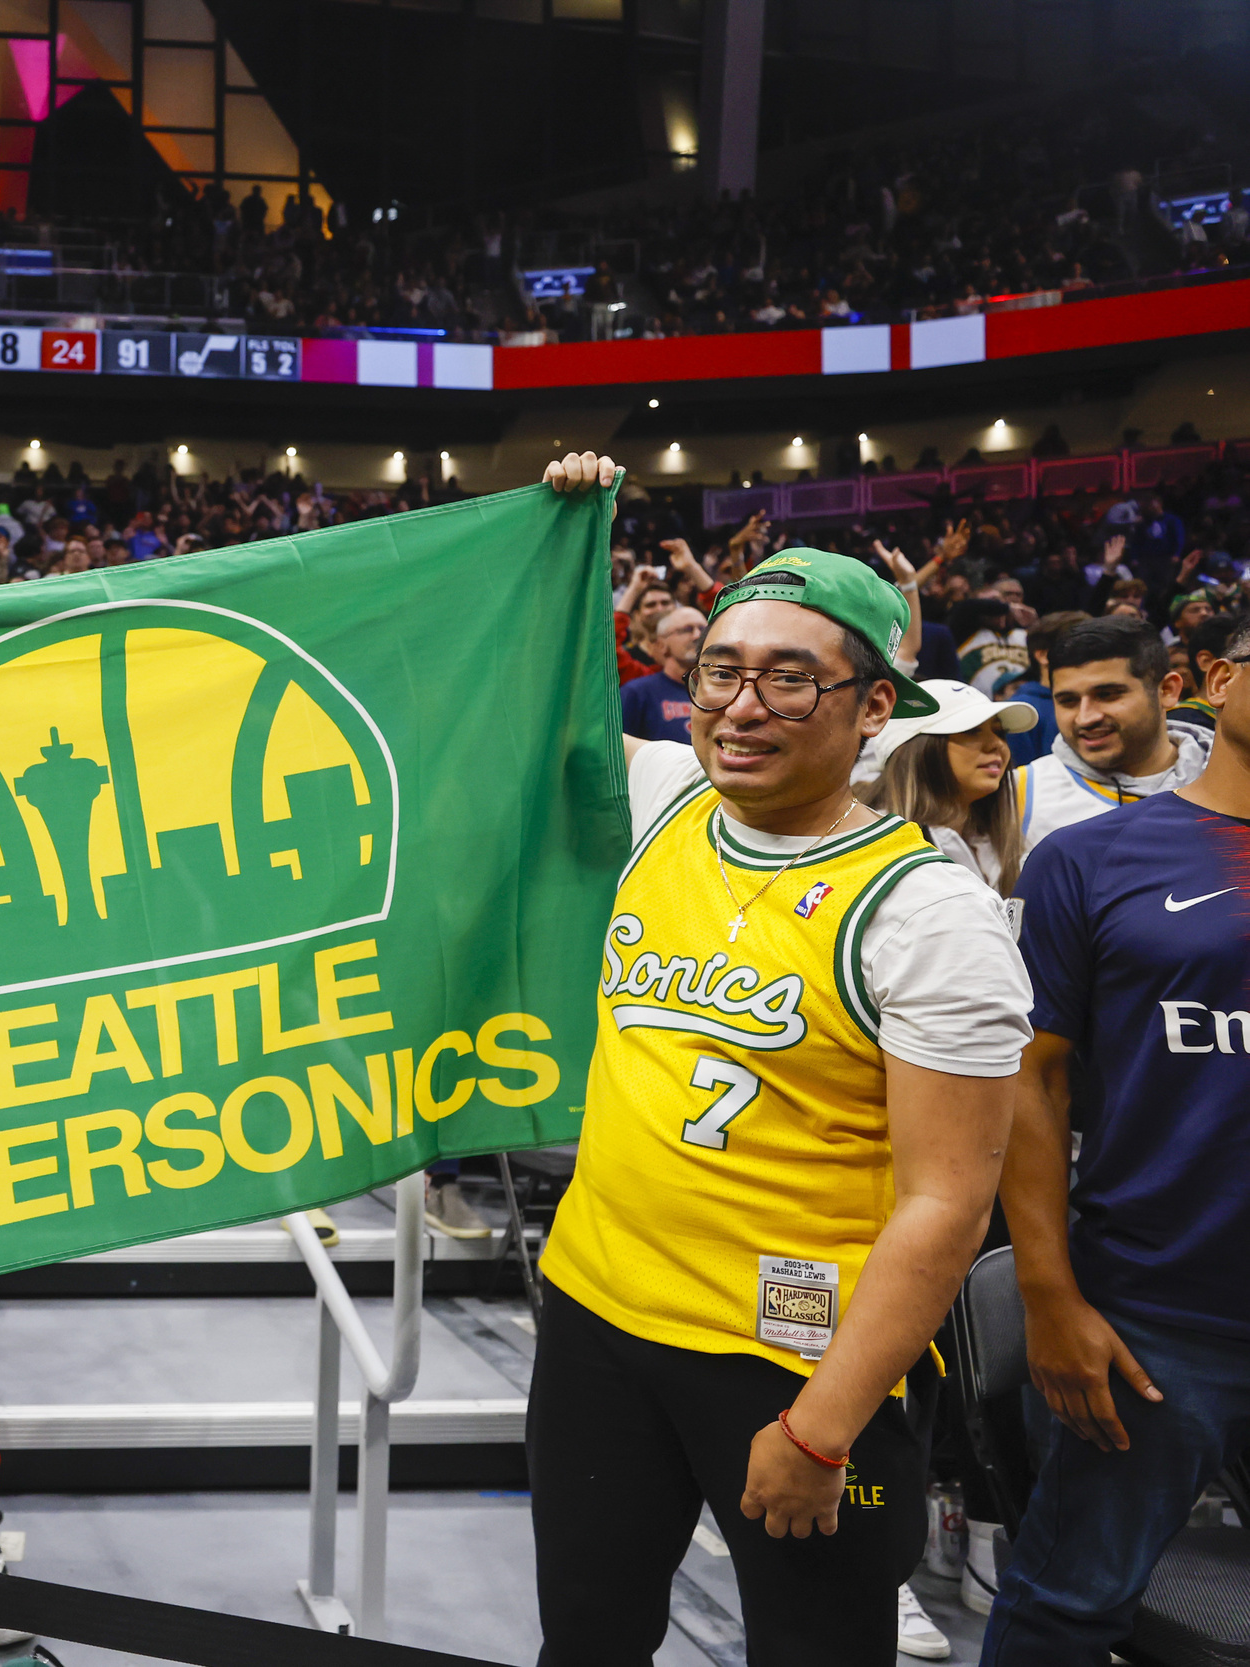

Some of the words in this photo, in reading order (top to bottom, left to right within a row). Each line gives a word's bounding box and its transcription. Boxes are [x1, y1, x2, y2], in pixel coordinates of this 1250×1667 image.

[52, 340, 86, 364] 24
[118, 339, 149, 369] 91
[251, 352, 266, 374] 5
[278, 353, 293, 376] 2
[601, 913, 806, 1030] Sonics
[681, 1055, 762, 1151] 7
[771, 1266, 803, 1278] RASHARD
[804, 1271, 826, 1281] LEWIS
[784, 1260, 814, 1270] 2003-04
[783, 1288, 826, 1308] HARDWOOD
[782, 1304, 826, 1323] CLASSICS
[764, 1328, 800, 1338] Mitchell
[807, 1330, 828, 1339] Ness
